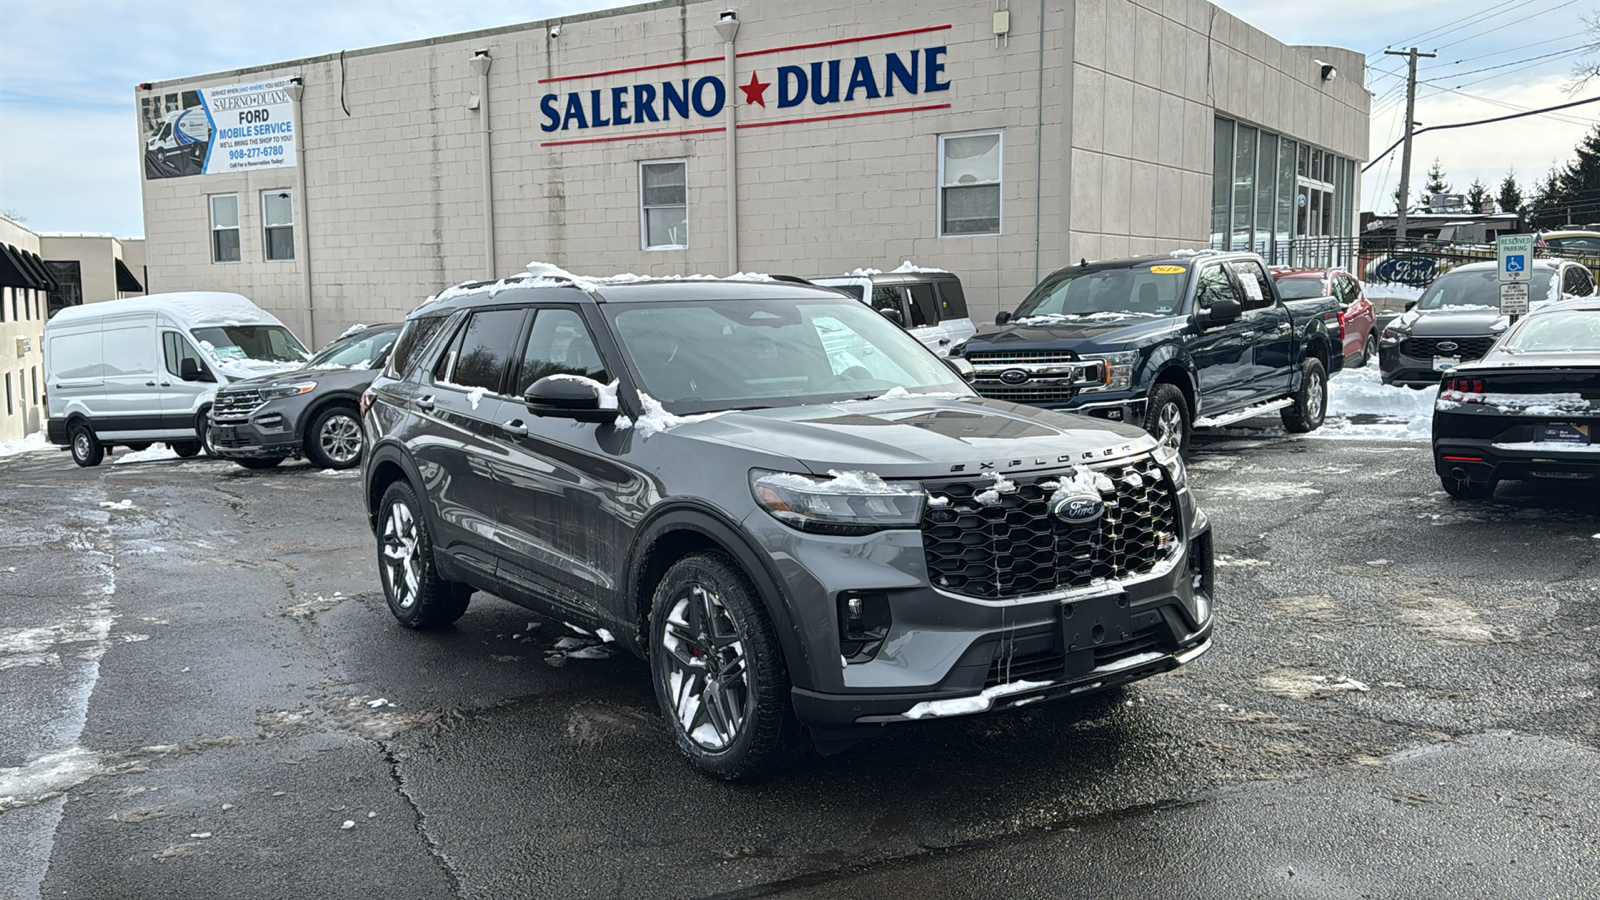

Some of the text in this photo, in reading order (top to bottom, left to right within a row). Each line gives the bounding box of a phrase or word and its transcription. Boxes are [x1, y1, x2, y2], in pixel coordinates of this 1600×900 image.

[540, 46, 952, 132] SALERNO DUANE
[214, 90, 289, 110] SALERNO DUANE
[239, 109, 269, 124] FORD
[219, 121, 292, 139] MOBILE SERVICE
[229, 145, 283, 160] 908-277-6780
[1390, 260, 1433, 280] Ford
[950, 445, 1131, 472] EXPLORER
[1069, 500, 1095, 517] Ford
